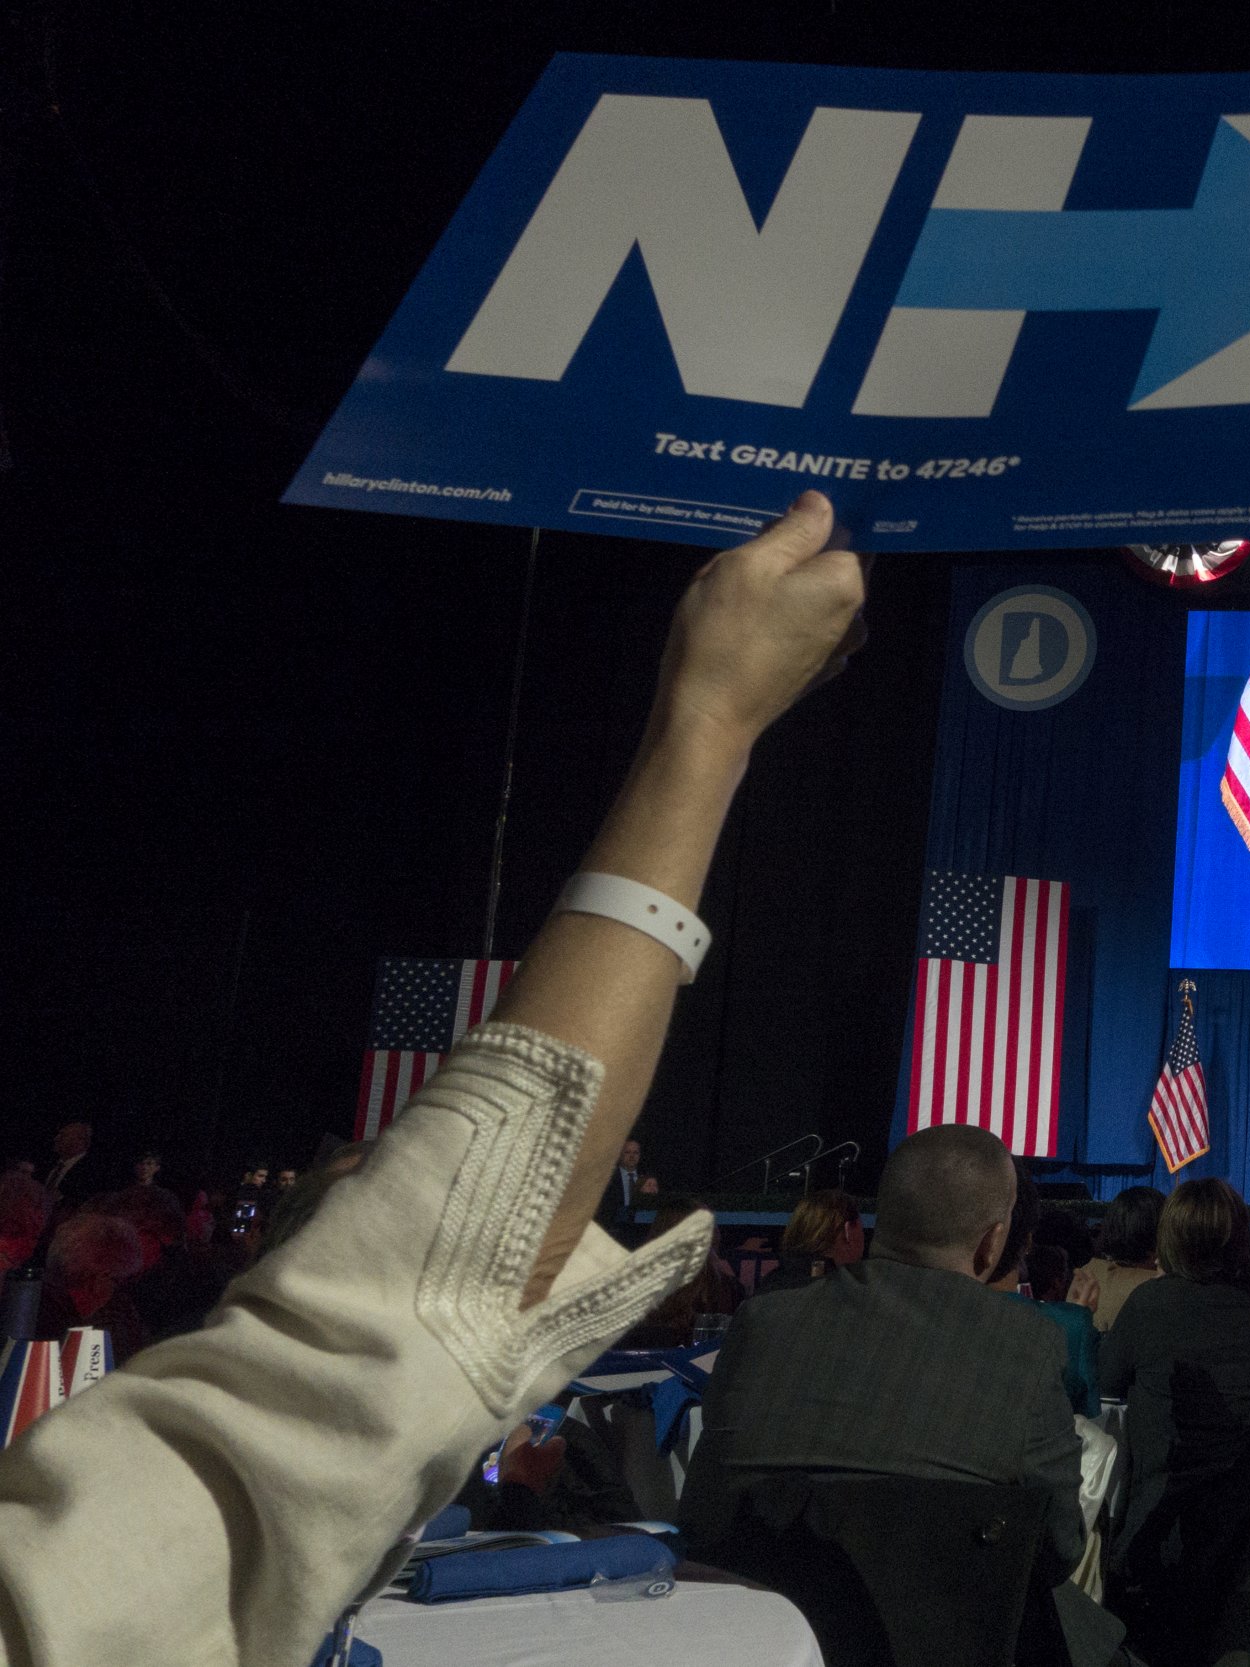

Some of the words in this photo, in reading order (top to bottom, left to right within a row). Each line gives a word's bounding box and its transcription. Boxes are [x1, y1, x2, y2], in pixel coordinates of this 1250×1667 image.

[654, 432, 725, 461] Text
[730, 444, 872, 480] GRANITE
[877, 460, 910, 481] to
[322, 471, 512, 502] hillaryclinton.com/nh
[655, 505, 693, 519] Hillary
[84, 1344, 101, 1380] Press
